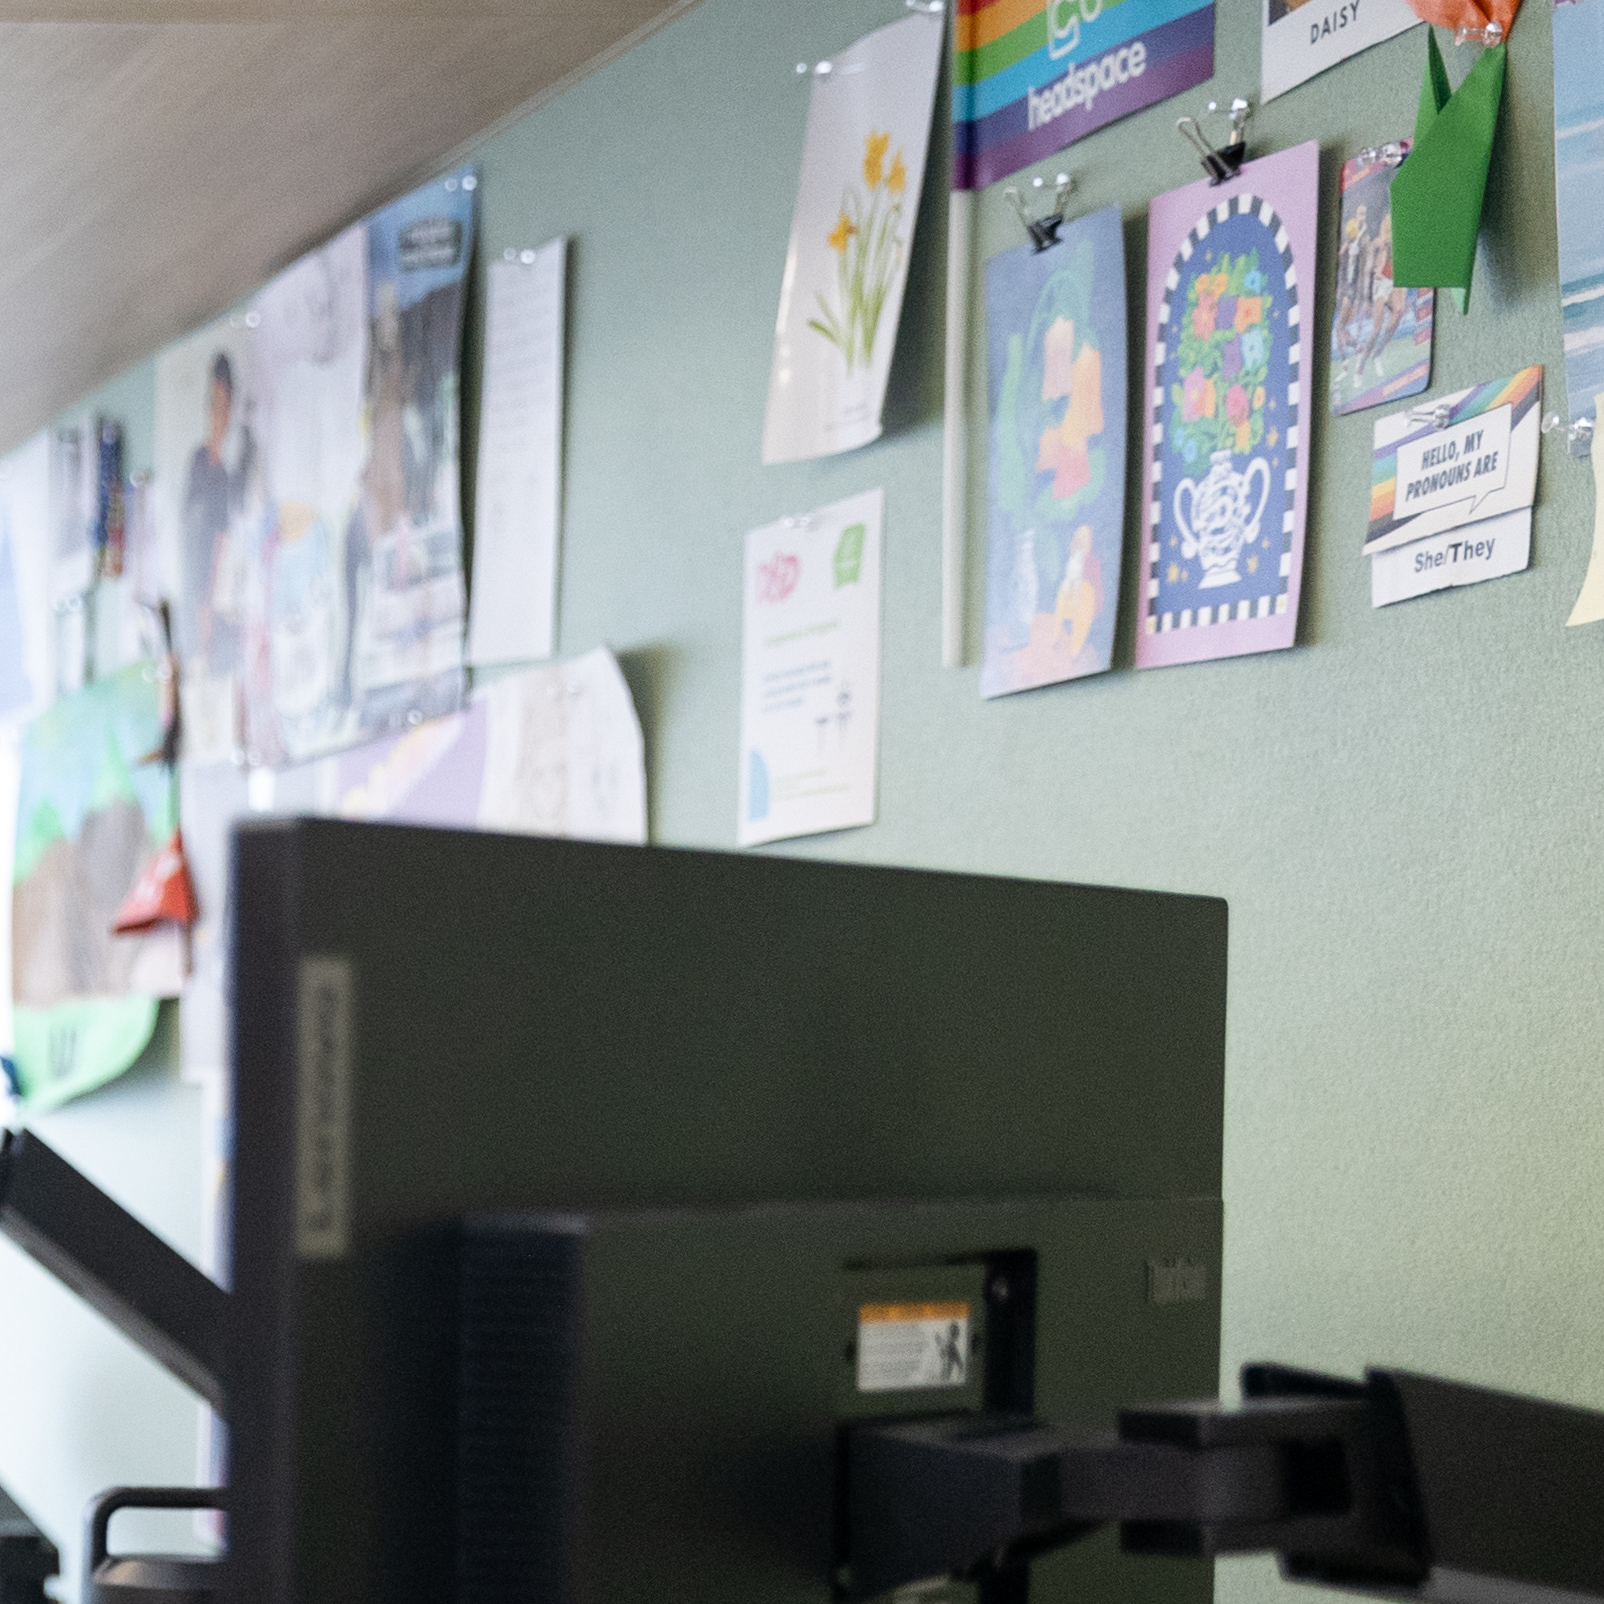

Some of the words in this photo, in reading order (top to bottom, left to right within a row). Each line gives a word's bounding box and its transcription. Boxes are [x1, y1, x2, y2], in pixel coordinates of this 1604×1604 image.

[1310, 0, 1360, 45] DAISY
[1027, 41, 1147, 131] headspace
[1420, 440, 1461, 471] HELLO,
[1463, 429, 1484, 455] MY
[1405, 460, 1472, 502] PRONOUNS
[1474, 450, 1499, 476] ARE
[1414, 538, 1496, 574] She/They
